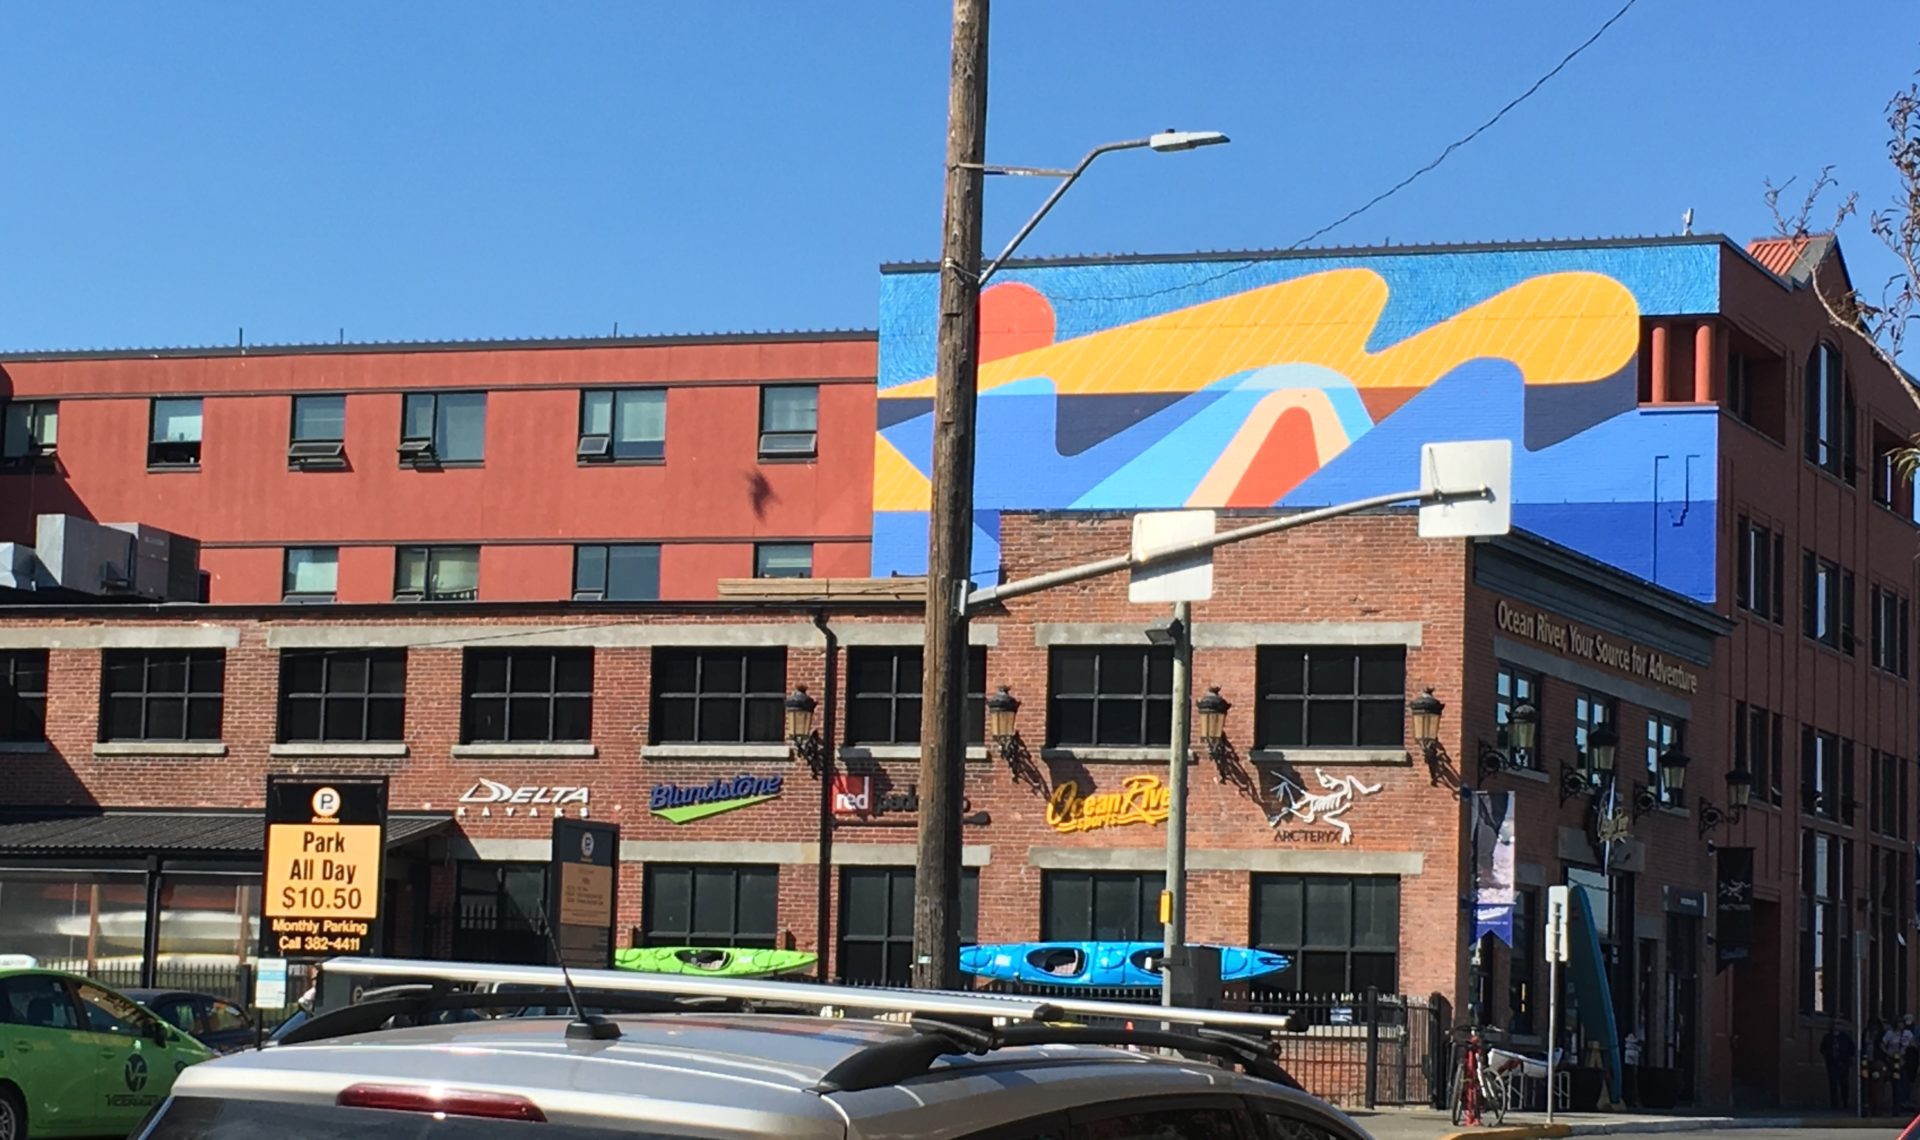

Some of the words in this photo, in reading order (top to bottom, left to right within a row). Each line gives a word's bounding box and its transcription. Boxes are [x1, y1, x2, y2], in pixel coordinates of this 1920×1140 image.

[1498, 600, 1534, 638] Ocean
[1537, 613, 1567, 652] River,
[1569, 625, 1594, 659] Your
[1596, 635, 1630, 671] Source
[1631, 645, 1647, 675] for
[1648, 653, 1698, 694] Adventure
[650, 774, 782, 809] Blundstone
[836, 776, 870, 810] red
[1120, 775, 1170, 825] Rive
[456, 806, 589, 818] KAYAKS
[303, 831, 346, 853] Park
[289, 859, 314, 881] All
[322, 859, 357, 885] Day
[282, 886, 362, 910] $10.50
[272, 919, 320, 934] Monthly
[323, 920, 368, 935] Parking
[279, 936, 301, 949] Call
[304, 936, 361, 950] 382-4411
